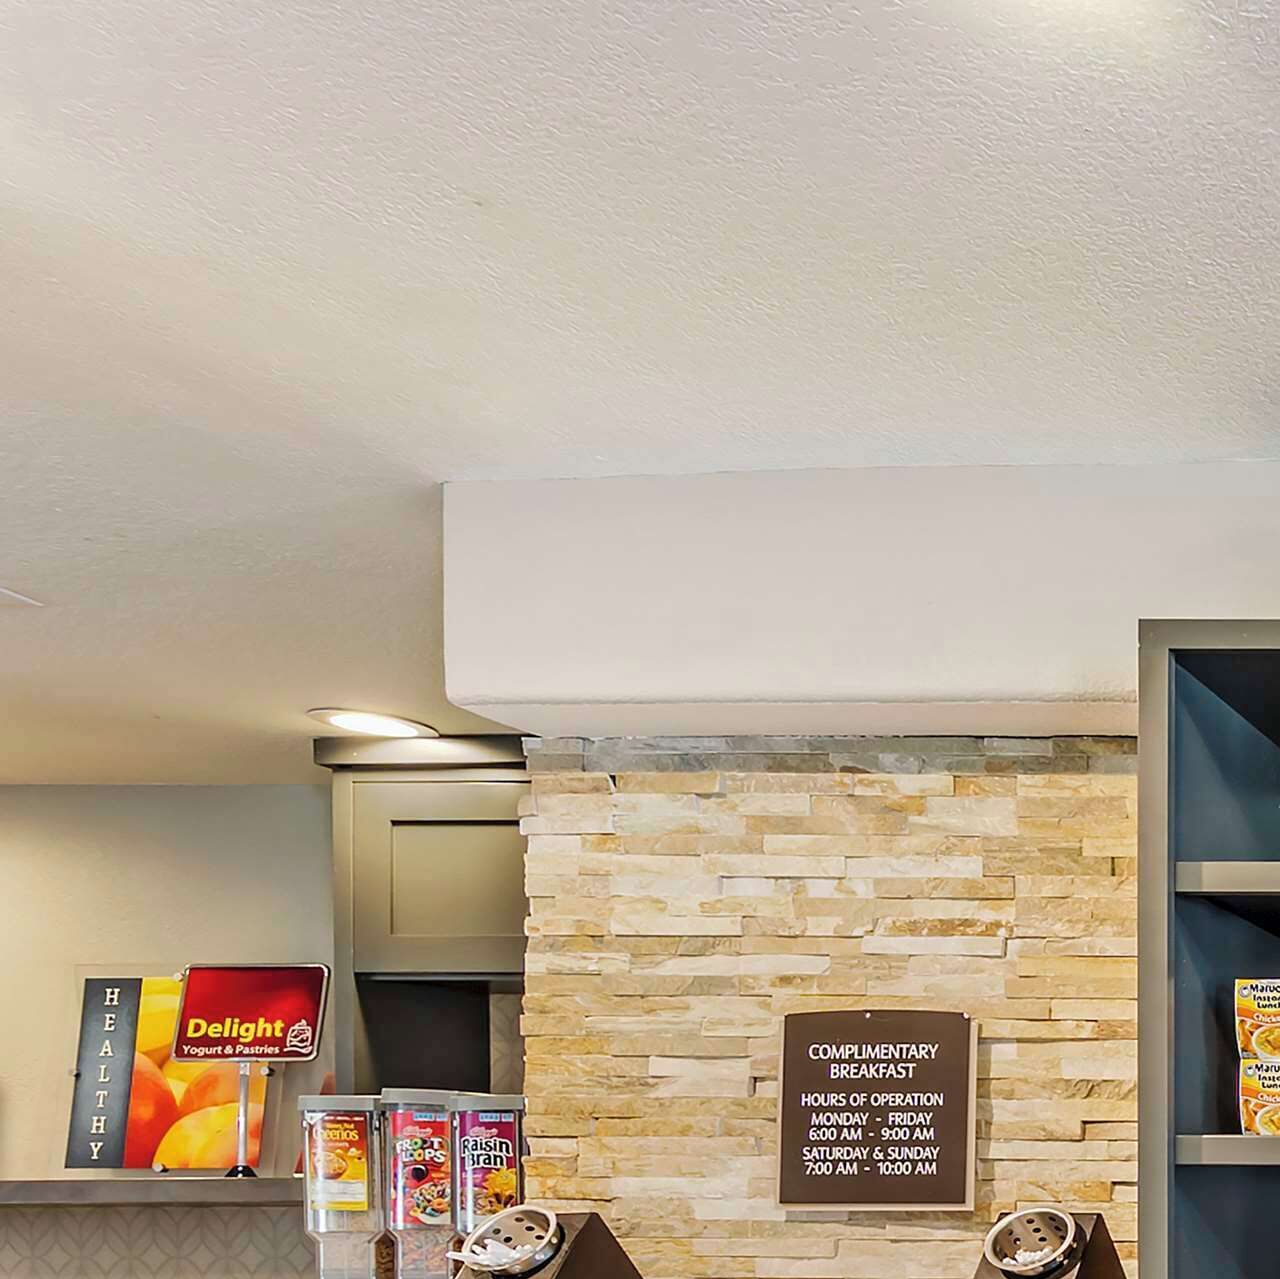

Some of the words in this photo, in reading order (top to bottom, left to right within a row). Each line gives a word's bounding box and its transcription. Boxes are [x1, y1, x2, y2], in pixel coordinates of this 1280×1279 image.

[187, 1018, 285, 1043] Delight
[182, 1044, 223, 1056] Yogurt
[223, 1044, 233, 1054] &
[235, 1043, 280, 1055] Pastries
[808, 1044, 939, 1060] COMPLIMENTARY
[90, 988, 121, 1160] HEALTHY
[829, 1063, 916, 1079] BREAKFAST
[801, 1093, 846, 1106] HOURS
[849, 1093, 867, 1106] OF
[870, 1093, 944, 1106] OPERATION
[811, 1113, 869, 1126] MONDAY
[888, 1113, 933, 1126] FRIDAY
[809, 1128, 837, 1140] 6:00
[840, 1128, 862, 1140] AM
[880, 1128, 910, 1140] 9:00
[912, 1128, 935, 1140] AM
[461, 1136, 511, 1156] Raisin
[803, 1147, 869, 1160] SATURDAY
[872, 1147, 884, 1160] &
[887, 1147, 940, 1160] SUNDAY
[805, 1162, 833, 1175] 7:00
[835, 1162, 858, 1175] AM
[877, 1162, 911, 1175] 10:00
[914, 1162, 937, 1175] AM
